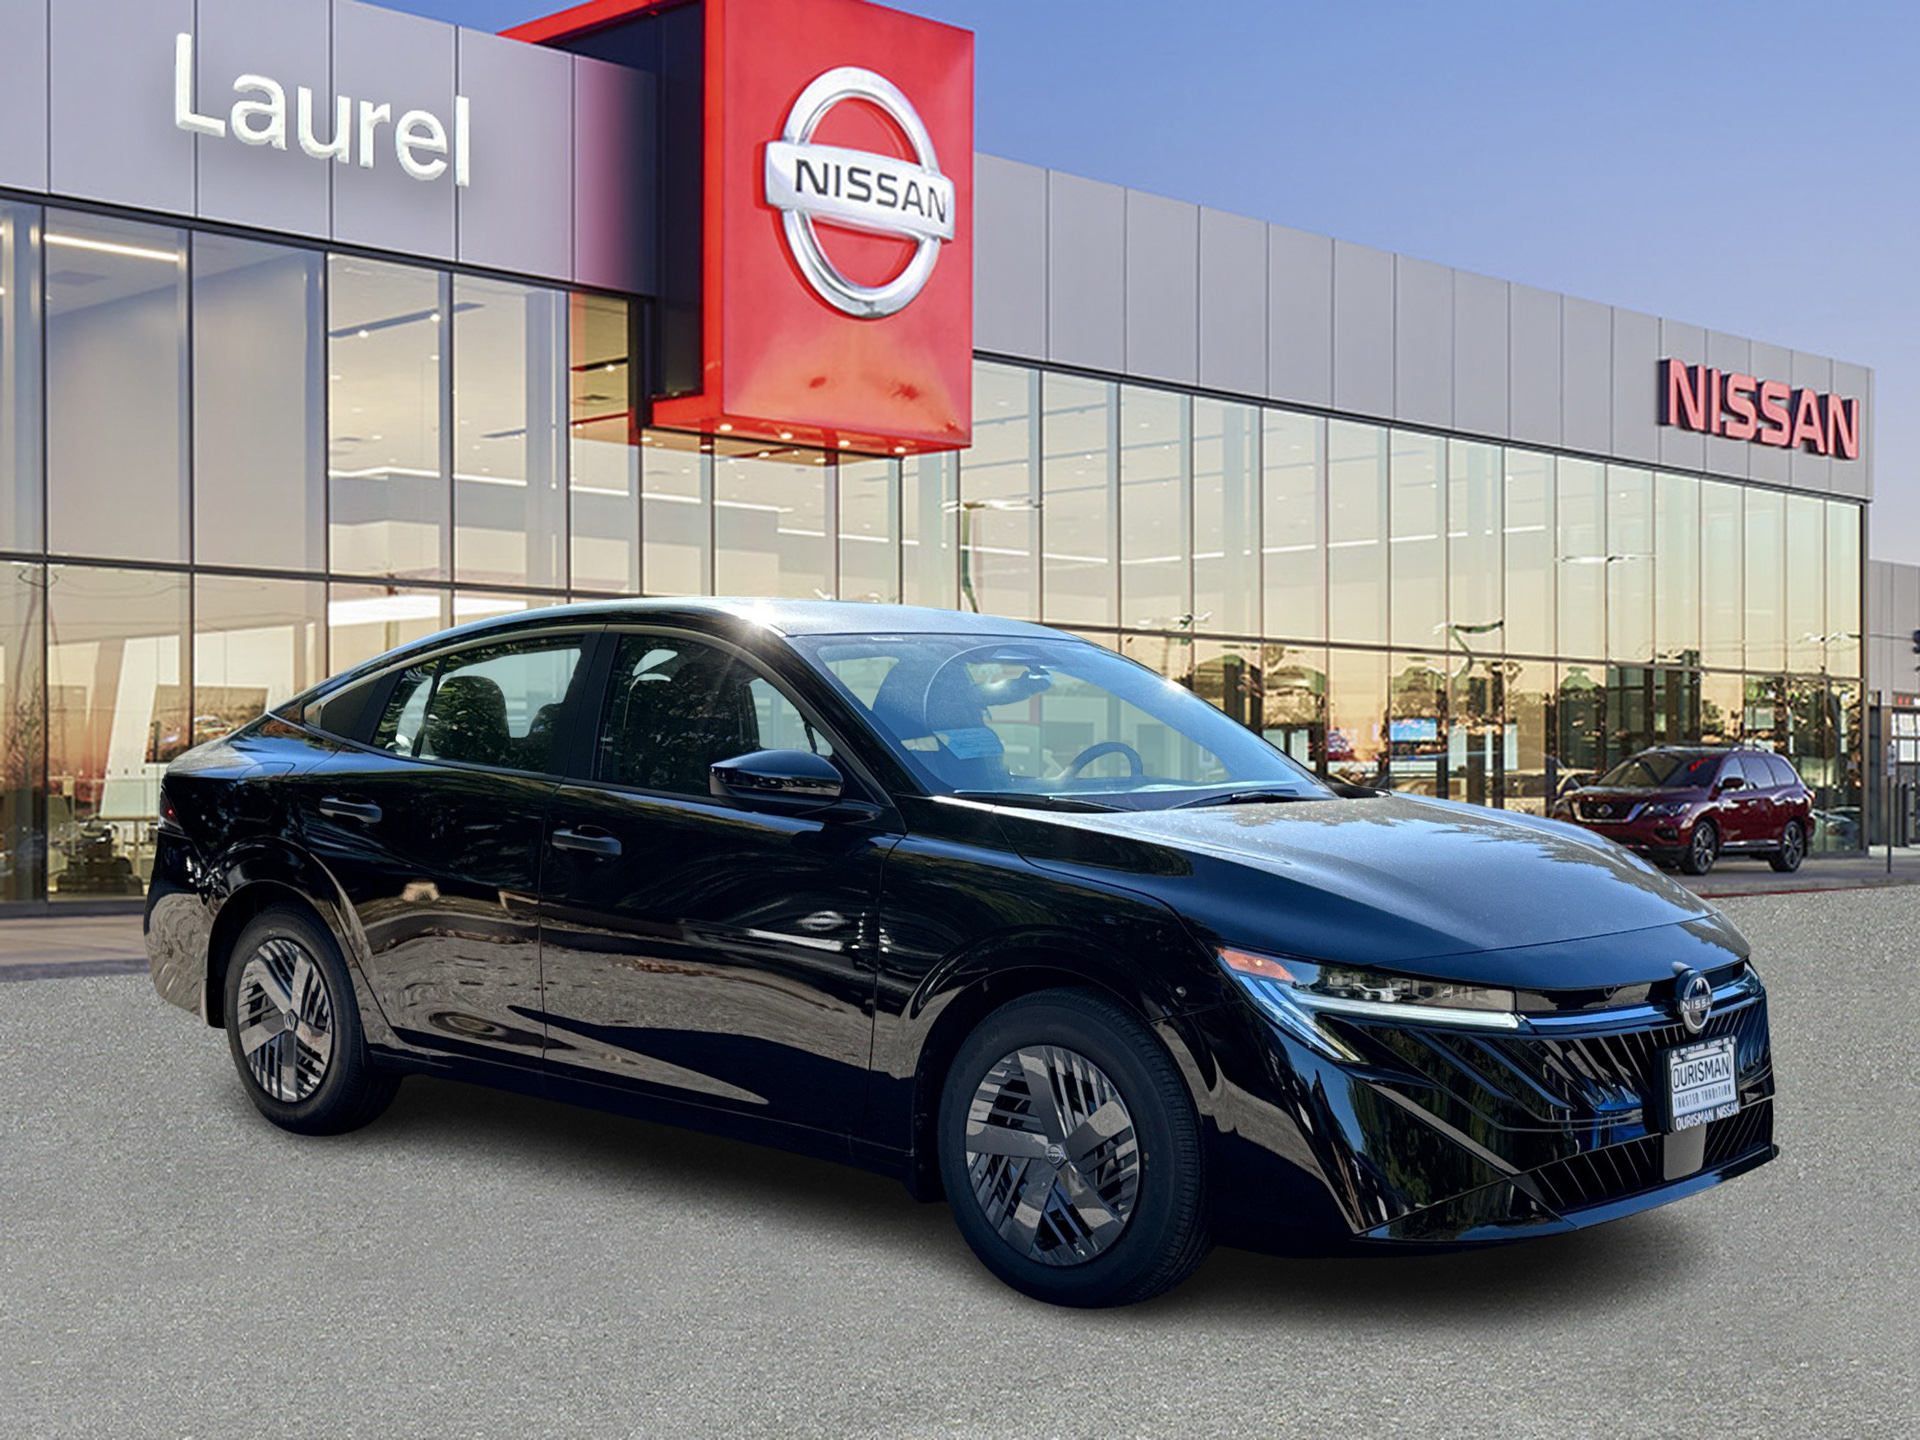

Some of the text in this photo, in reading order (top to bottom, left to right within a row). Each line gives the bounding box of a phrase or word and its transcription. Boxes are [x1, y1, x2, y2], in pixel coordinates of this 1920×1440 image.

[175, 32, 470, 188] Laurel
[795, 158, 946, 224] NISSAN
[1661, 358, 1860, 460] NISSAN
[1682, 997, 1711, 1011] NISSA
[1673, 1056, 1730, 1089] OURISMAN
[1675, 1100, 1740, 1131] OURISMAN NISSAN
